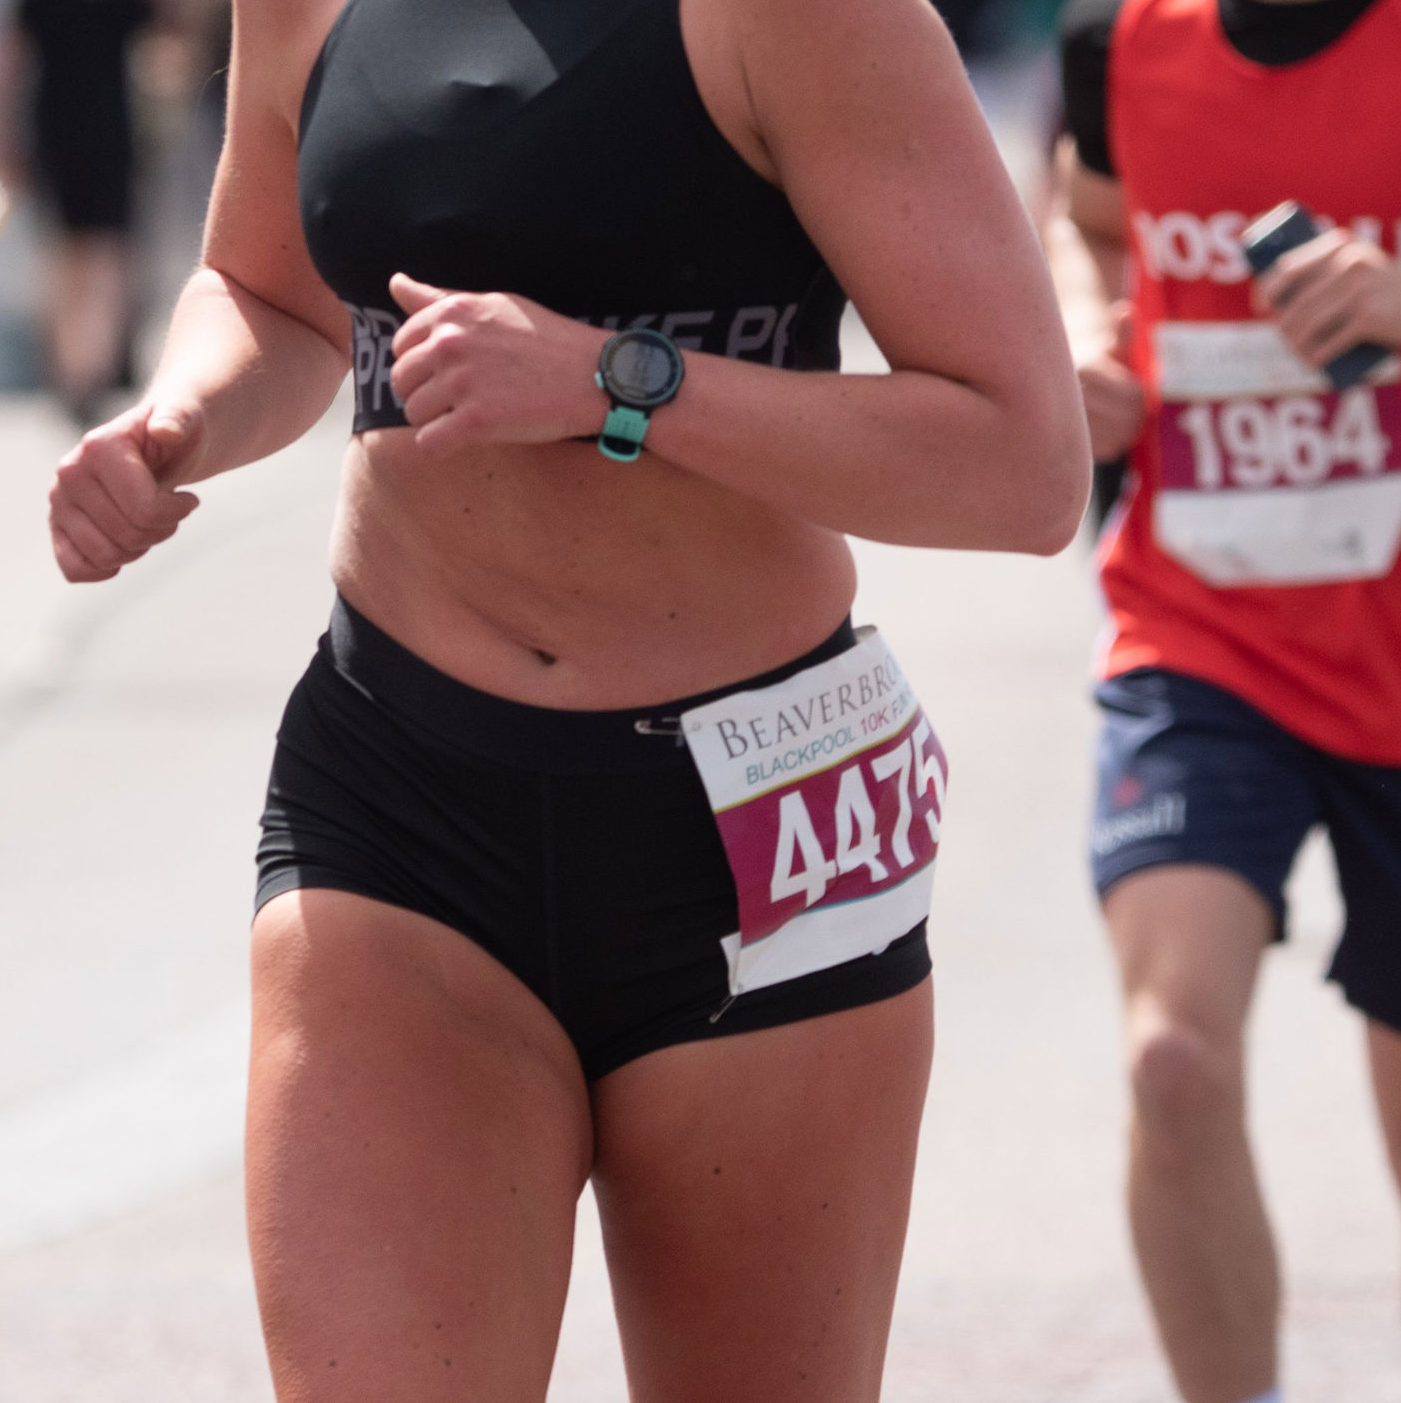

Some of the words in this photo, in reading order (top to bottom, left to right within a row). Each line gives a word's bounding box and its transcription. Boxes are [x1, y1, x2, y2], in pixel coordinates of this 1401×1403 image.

[1177, 385, 1392, 490] 1964
[746, 725, 856, 785] BLACKPOOL
[860, 706, 890, 735] 10K
[770, 716, 946, 909] 4475
